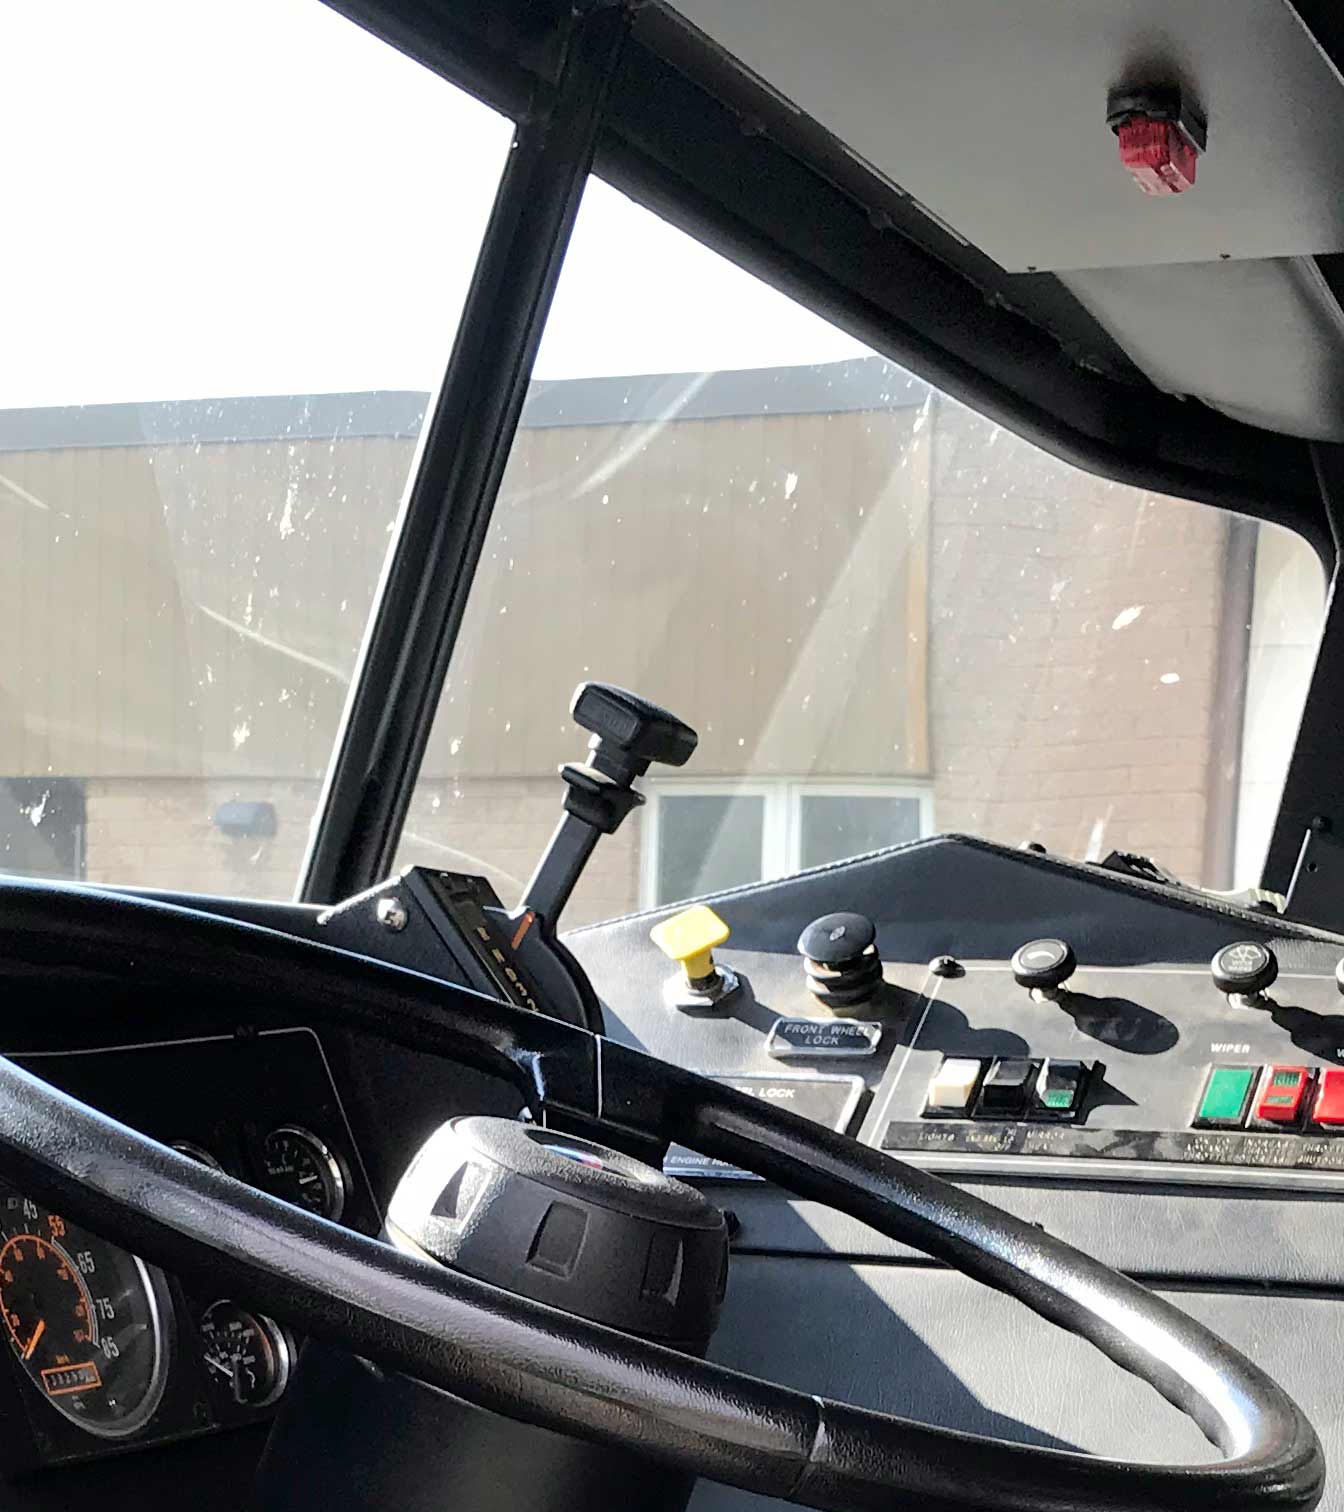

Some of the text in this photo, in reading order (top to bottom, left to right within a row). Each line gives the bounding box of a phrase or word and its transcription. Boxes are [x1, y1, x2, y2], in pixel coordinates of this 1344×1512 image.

[784, 1023, 870, 1036] FRONT WHEEL
[805, 1035, 839, 1045] LOCK
[1211, 1043, 1250, 1053] WIPER
[759, 1087, 795, 1098] LOCK
[670, 1156, 711, 1165] ENGINE
[23, 1198, 38, 1219] 45
[48, 1214, 66, 1237] 55
[77, 1252, 95, 1274] 65
[96, 1297, 115, 1319] 75
[100, 1337, 120, 1359] 85
